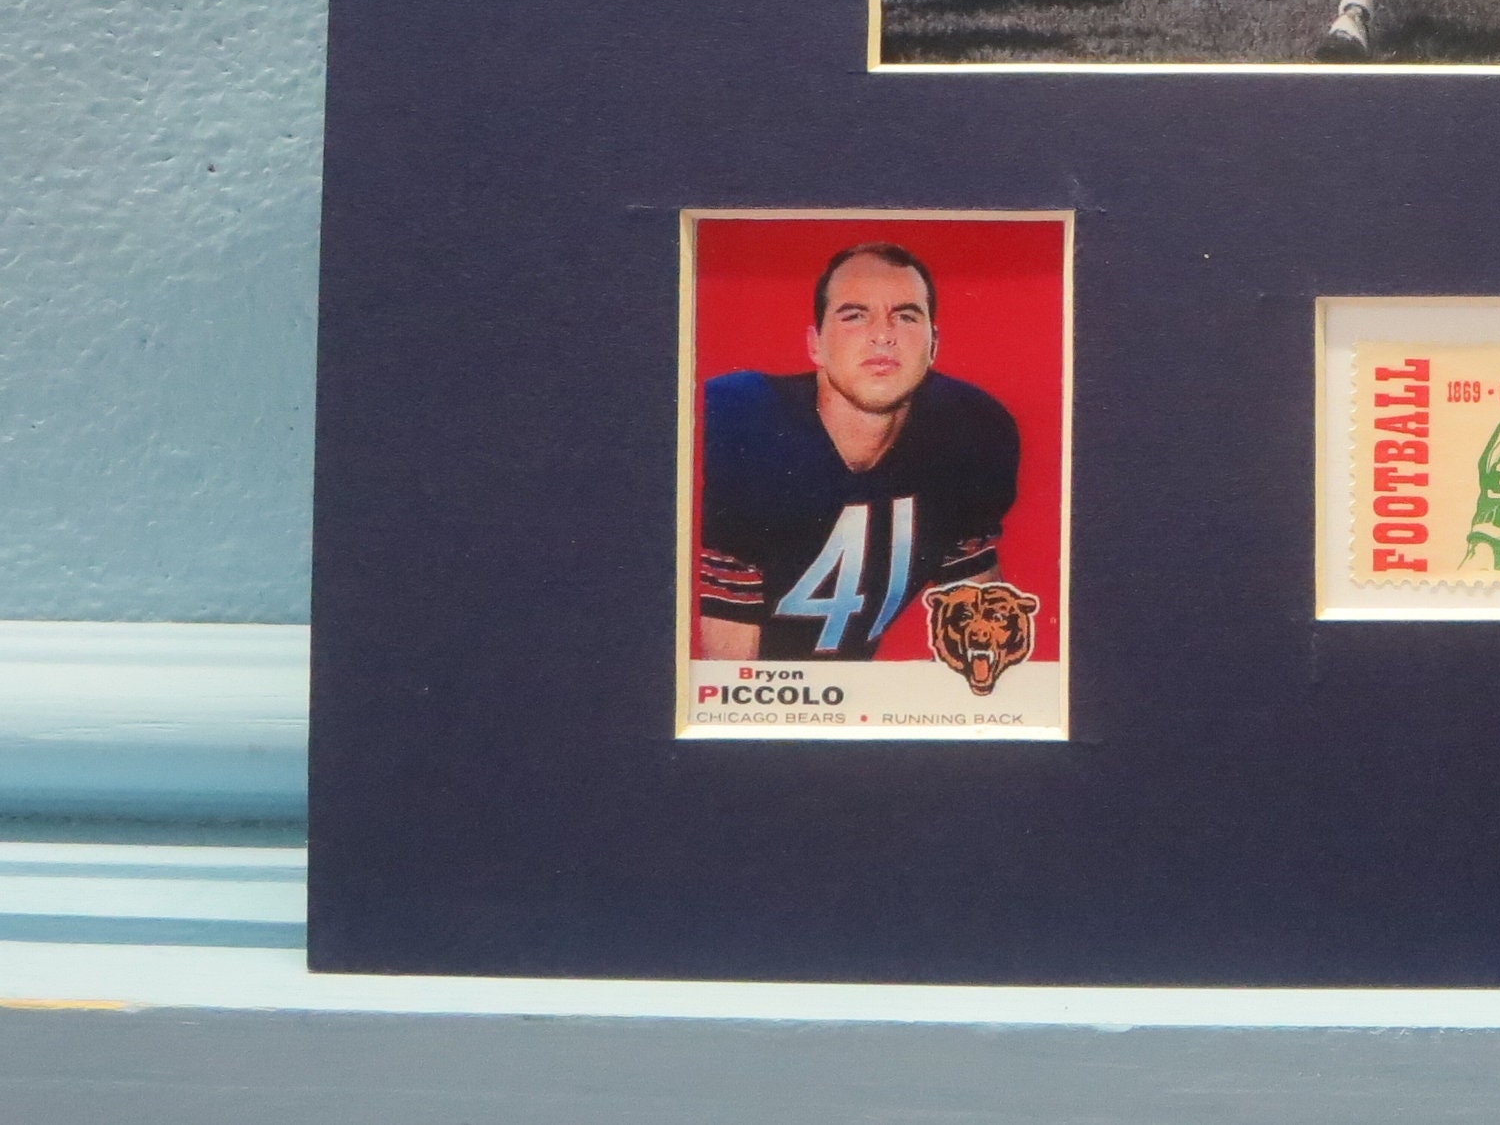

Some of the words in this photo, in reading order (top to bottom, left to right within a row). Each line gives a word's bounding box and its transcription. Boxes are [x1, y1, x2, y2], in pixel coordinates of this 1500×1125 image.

[1447, 381, 1481, 403] 1869
[1373, 358, 1431, 572] FOOTBALL
[774, 496, 914, 653] 41
[739, 667, 804, 682] Bryon
[698, 685, 844, 705] PICCOLO
[696, 712, 778, 724] CHICAGO
[785, 712, 846, 724] BEARS
[882, 713, 967, 724] RUNNING
[974, 713, 1023, 724] BACK
